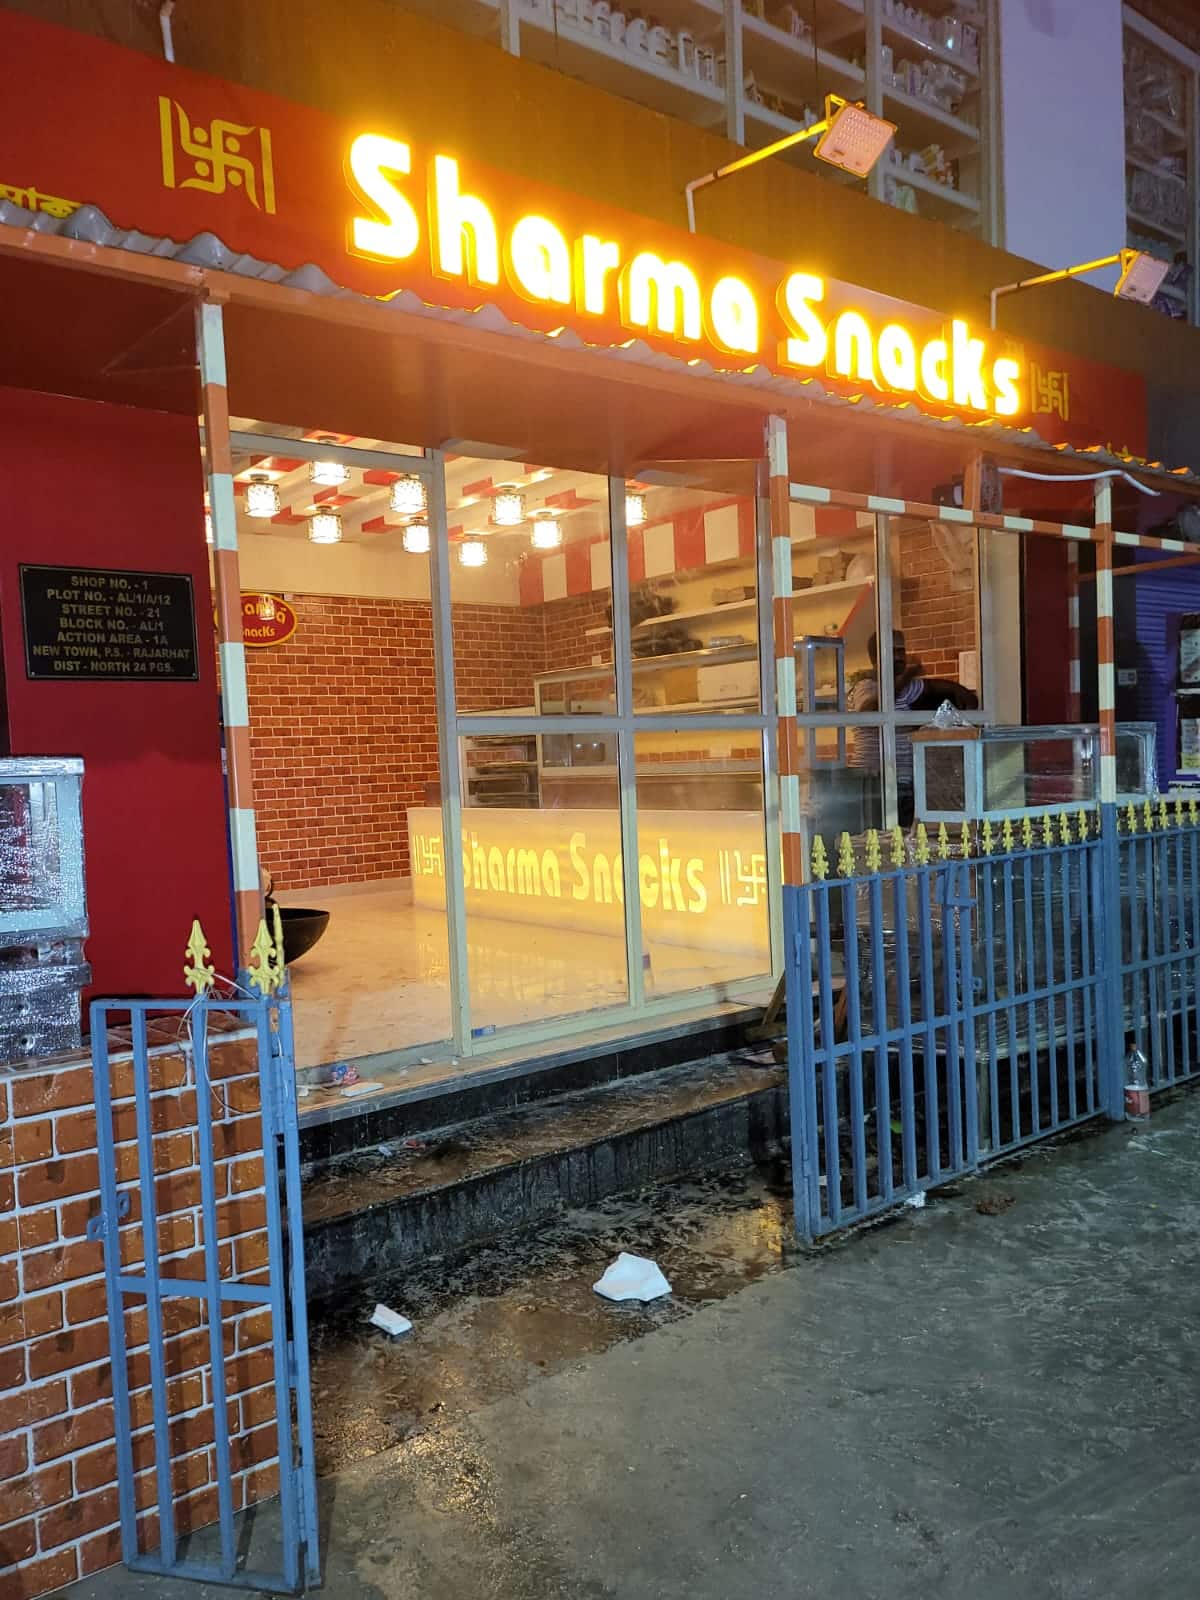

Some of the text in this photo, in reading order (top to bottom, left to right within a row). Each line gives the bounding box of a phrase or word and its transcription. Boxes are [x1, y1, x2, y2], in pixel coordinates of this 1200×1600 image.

[346, 132, 759, 354] Sharma
[778, 272, 1020, 416] Snacks
[71, 575, 106, 588] SHOP
[110, 579, 132, 590] NO.
[47, 589, 81, 601] PLOT
[84, 591, 107, 602] NO.
[61, 604, 112, 617] STREET
[115, 606, 137, 617] NO.
[147, 607, 161, 618] 21
[59, 617, 104, 630] BLOCK
[107, 619, 129, 631] NO.
[244, 625, 276, 638] nacks
[57, 632, 106, 644] ACTION
[109, 633, 143, 645] AREA
[153, 635, 169, 646] 1A
[32, 645, 61, 657] NEW
[64, 646, 102, 660] TOWN,
[133, 647, 192, 660] RAJARHAT
[53, 660, 81, 672] DIST
[91, 661, 130, 673] NORTH
[133, 662, 147, 673] 24
[149, 662, 175, 673] PGS.
